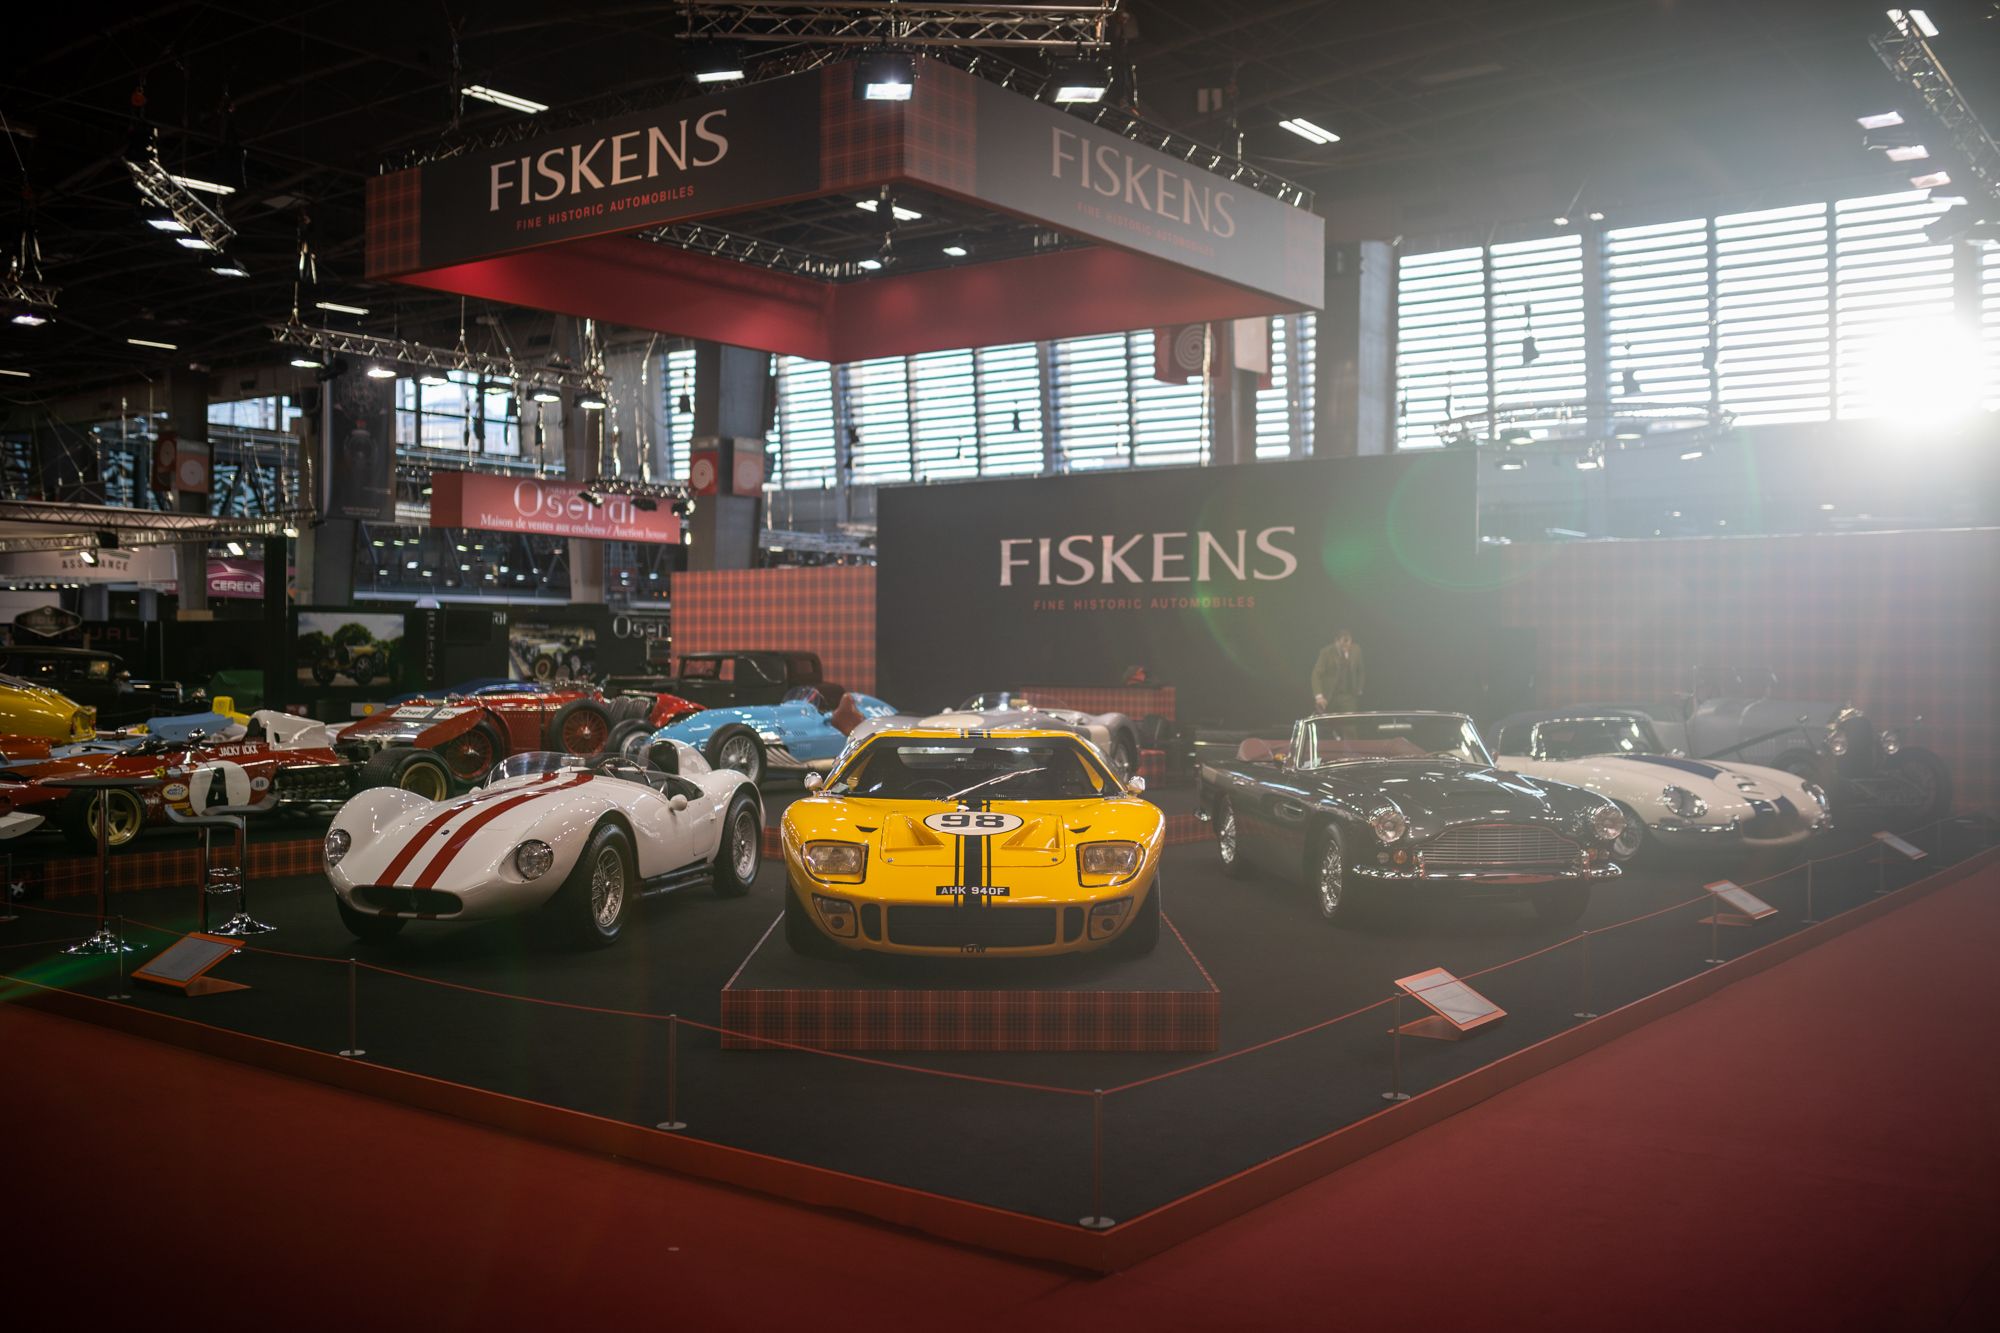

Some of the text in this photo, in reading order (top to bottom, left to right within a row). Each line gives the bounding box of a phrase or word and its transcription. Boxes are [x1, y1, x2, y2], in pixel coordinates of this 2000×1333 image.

[490, 109, 729, 212] FISKENS
[1051, 126, 1236, 239] FISKENS
[516, 185, 695, 231] FINE HISTORIC AUTOMOBILES
[480, 513, 513, 528] Maison
[515, 517, 526, 529] de
[527, 520, 553, 531] ventes
[556, 523, 570, 533] aux
[613, 526, 644, 538] Auction
[1000, 526, 1298, 586] FISKENS
[62, 560, 129, 572] ASSANCE
[1033, 596, 1256, 611] FINE HISTORIC AUTOMOBILES
[396, 708, 430, 717] Shell
[218, 744, 259, 757] JACKY ICKX
[939, 814, 1005, 829] 98
[941, 886, 966, 895] AHK
